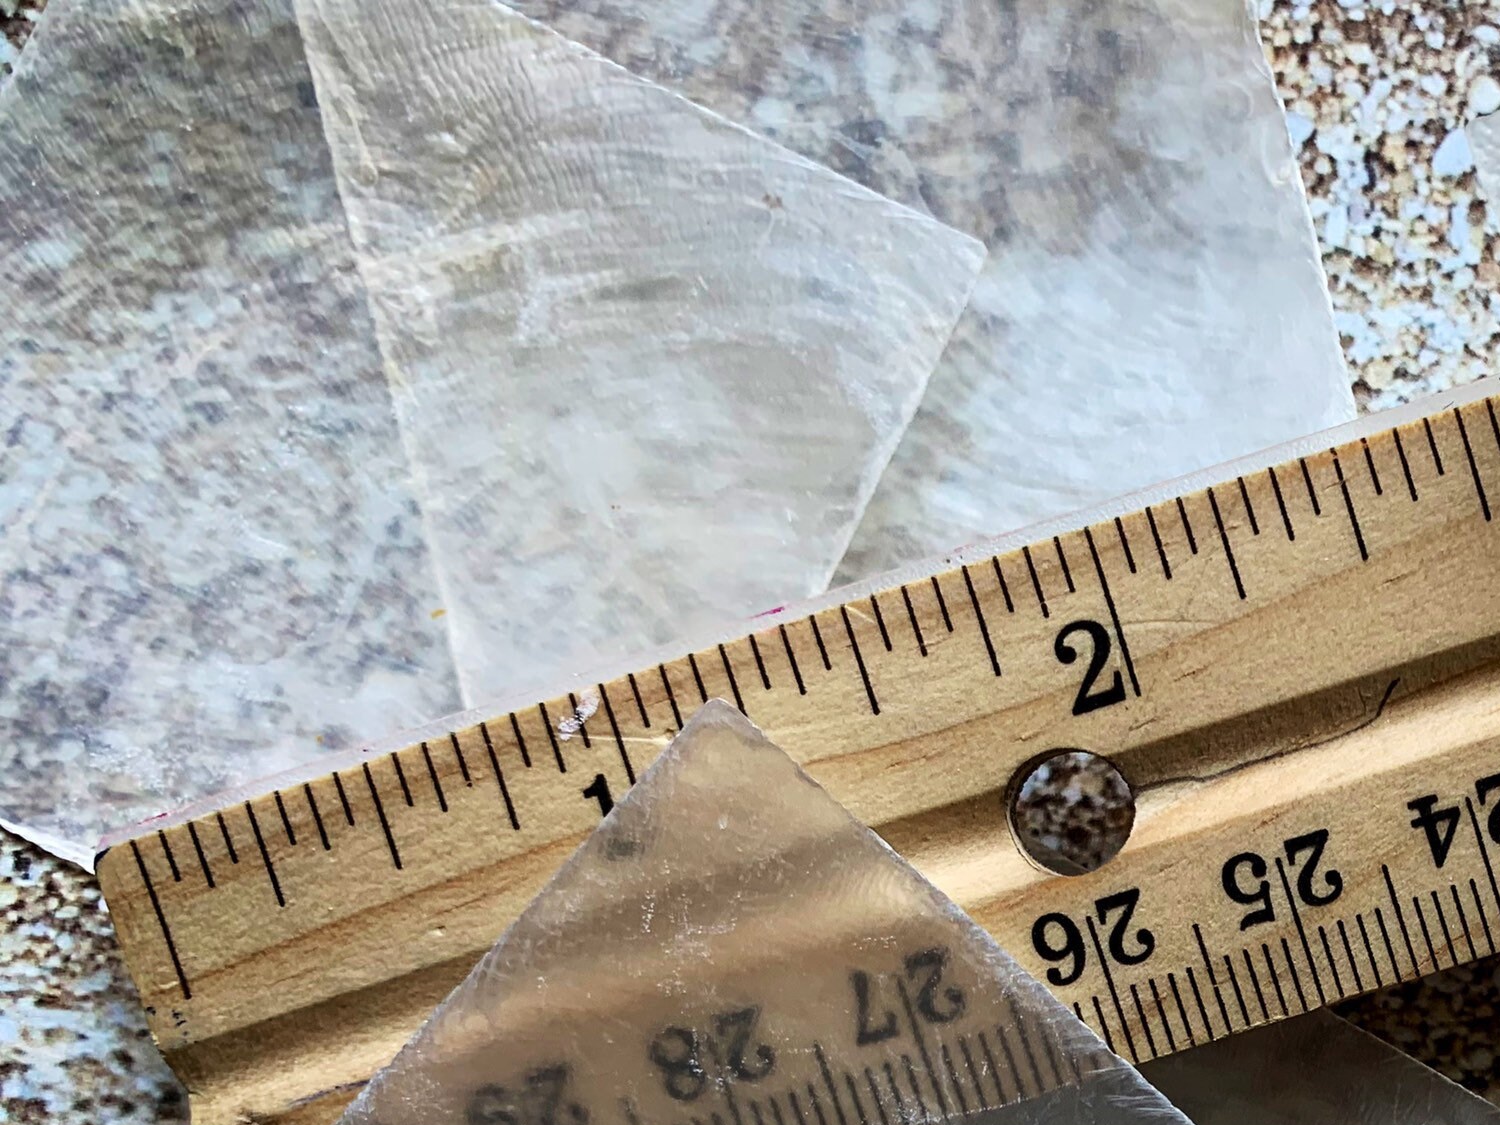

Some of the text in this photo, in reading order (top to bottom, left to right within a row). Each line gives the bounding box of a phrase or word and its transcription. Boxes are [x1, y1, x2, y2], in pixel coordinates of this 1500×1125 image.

[1054, 619, 1127, 716] 2
[1221, 829, 1343, 932] 25
[1032, 888, 1156, 987] 26
[850, 946, 966, 1047] 27
[649, 1003, 777, 1101] 28
